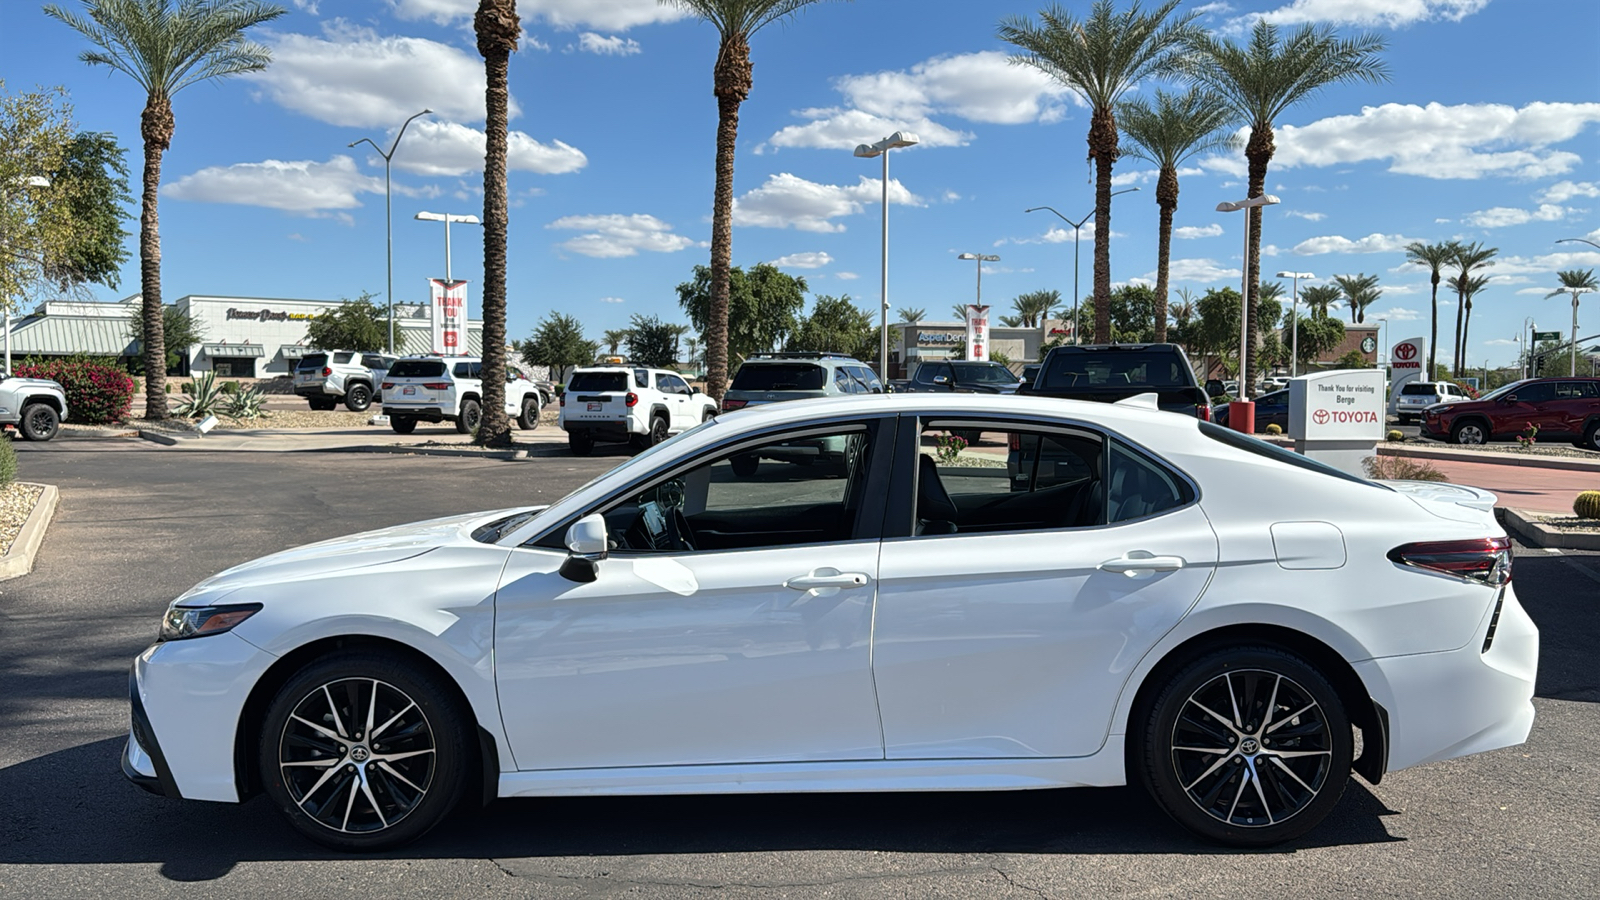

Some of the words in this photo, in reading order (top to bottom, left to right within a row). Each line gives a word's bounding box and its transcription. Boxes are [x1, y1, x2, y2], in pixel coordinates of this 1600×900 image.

[437, 297, 463, 307] THANK
[443, 308, 458, 318] YOU
[1392, 361, 1420, 369] TOYOTA
[1318, 384, 1334, 392] Thank
[1336, 384, 1345, 392] You
[1346, 384, 1354, 392] for
[1355, 385, 1375, 394] visiting
[1336, 395, 1355, 405] Berge
[1331, 411, 1378, 423] TOYOTA
